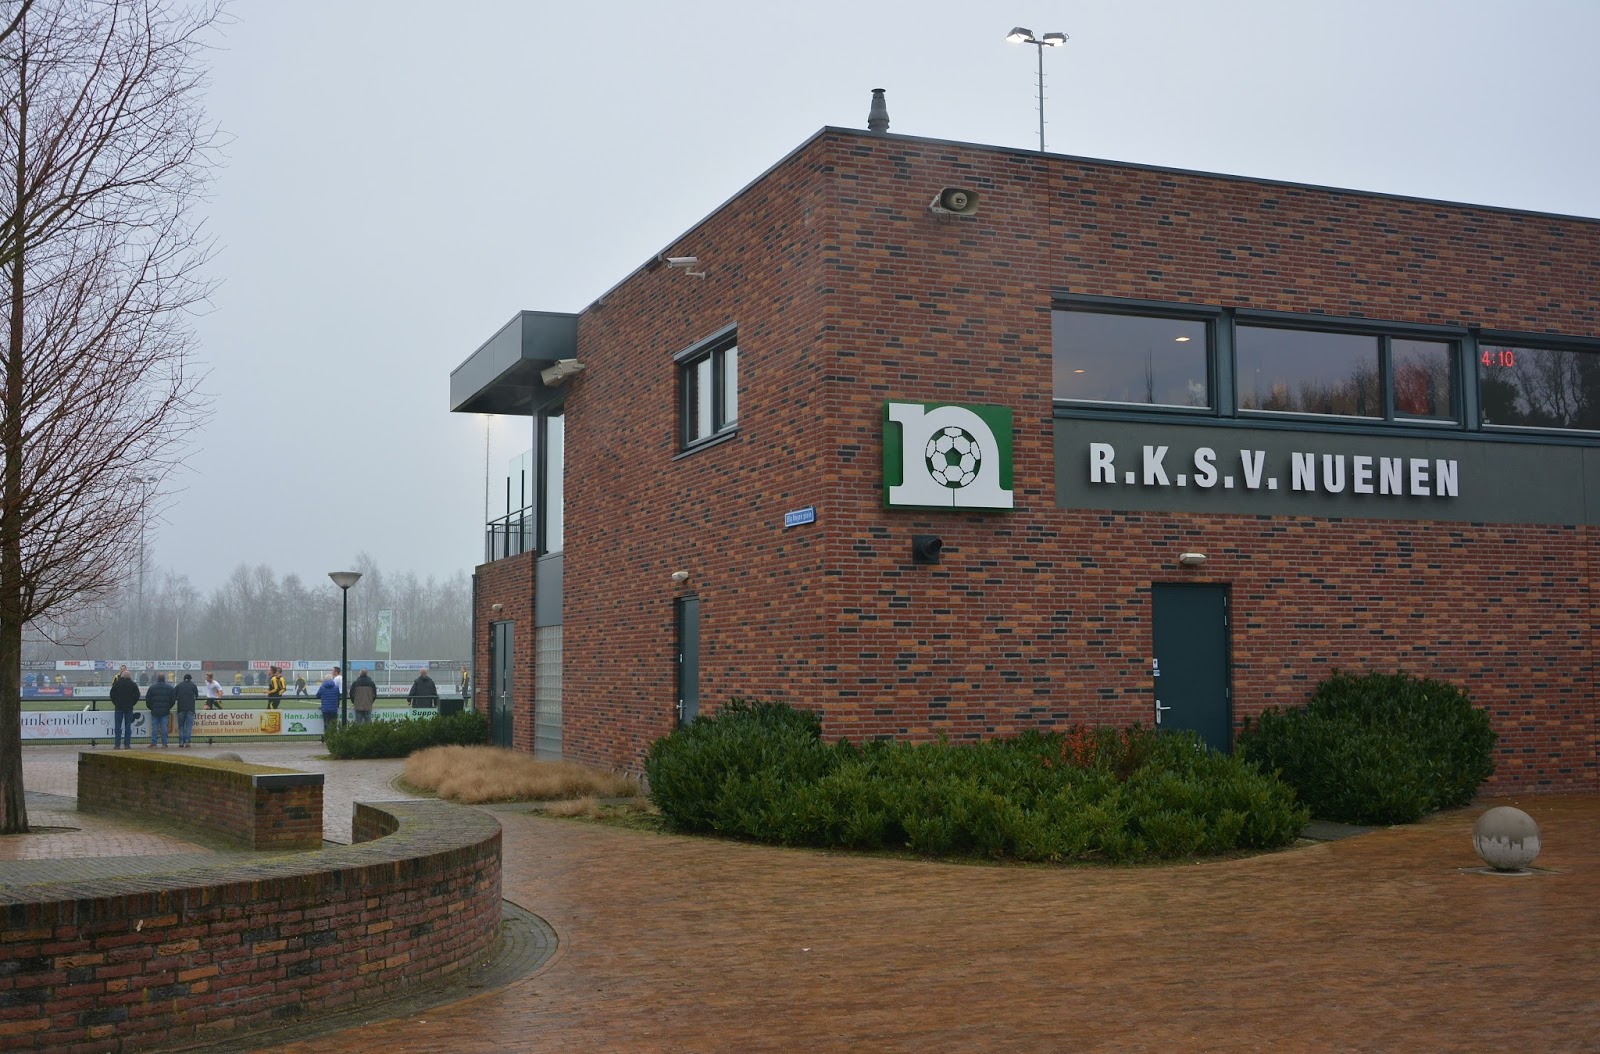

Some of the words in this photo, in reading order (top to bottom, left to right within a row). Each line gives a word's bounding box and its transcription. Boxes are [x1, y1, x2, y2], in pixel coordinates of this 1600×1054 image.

[1089, 442, 1278, 490] R.K.S.V.
[1291, 452, 1459, 497] NUENEN
[194, 712, 217, 720] lfried
[412, 709, 437, 717] Suppo
[20, 713, 98, 726] unkemöller
